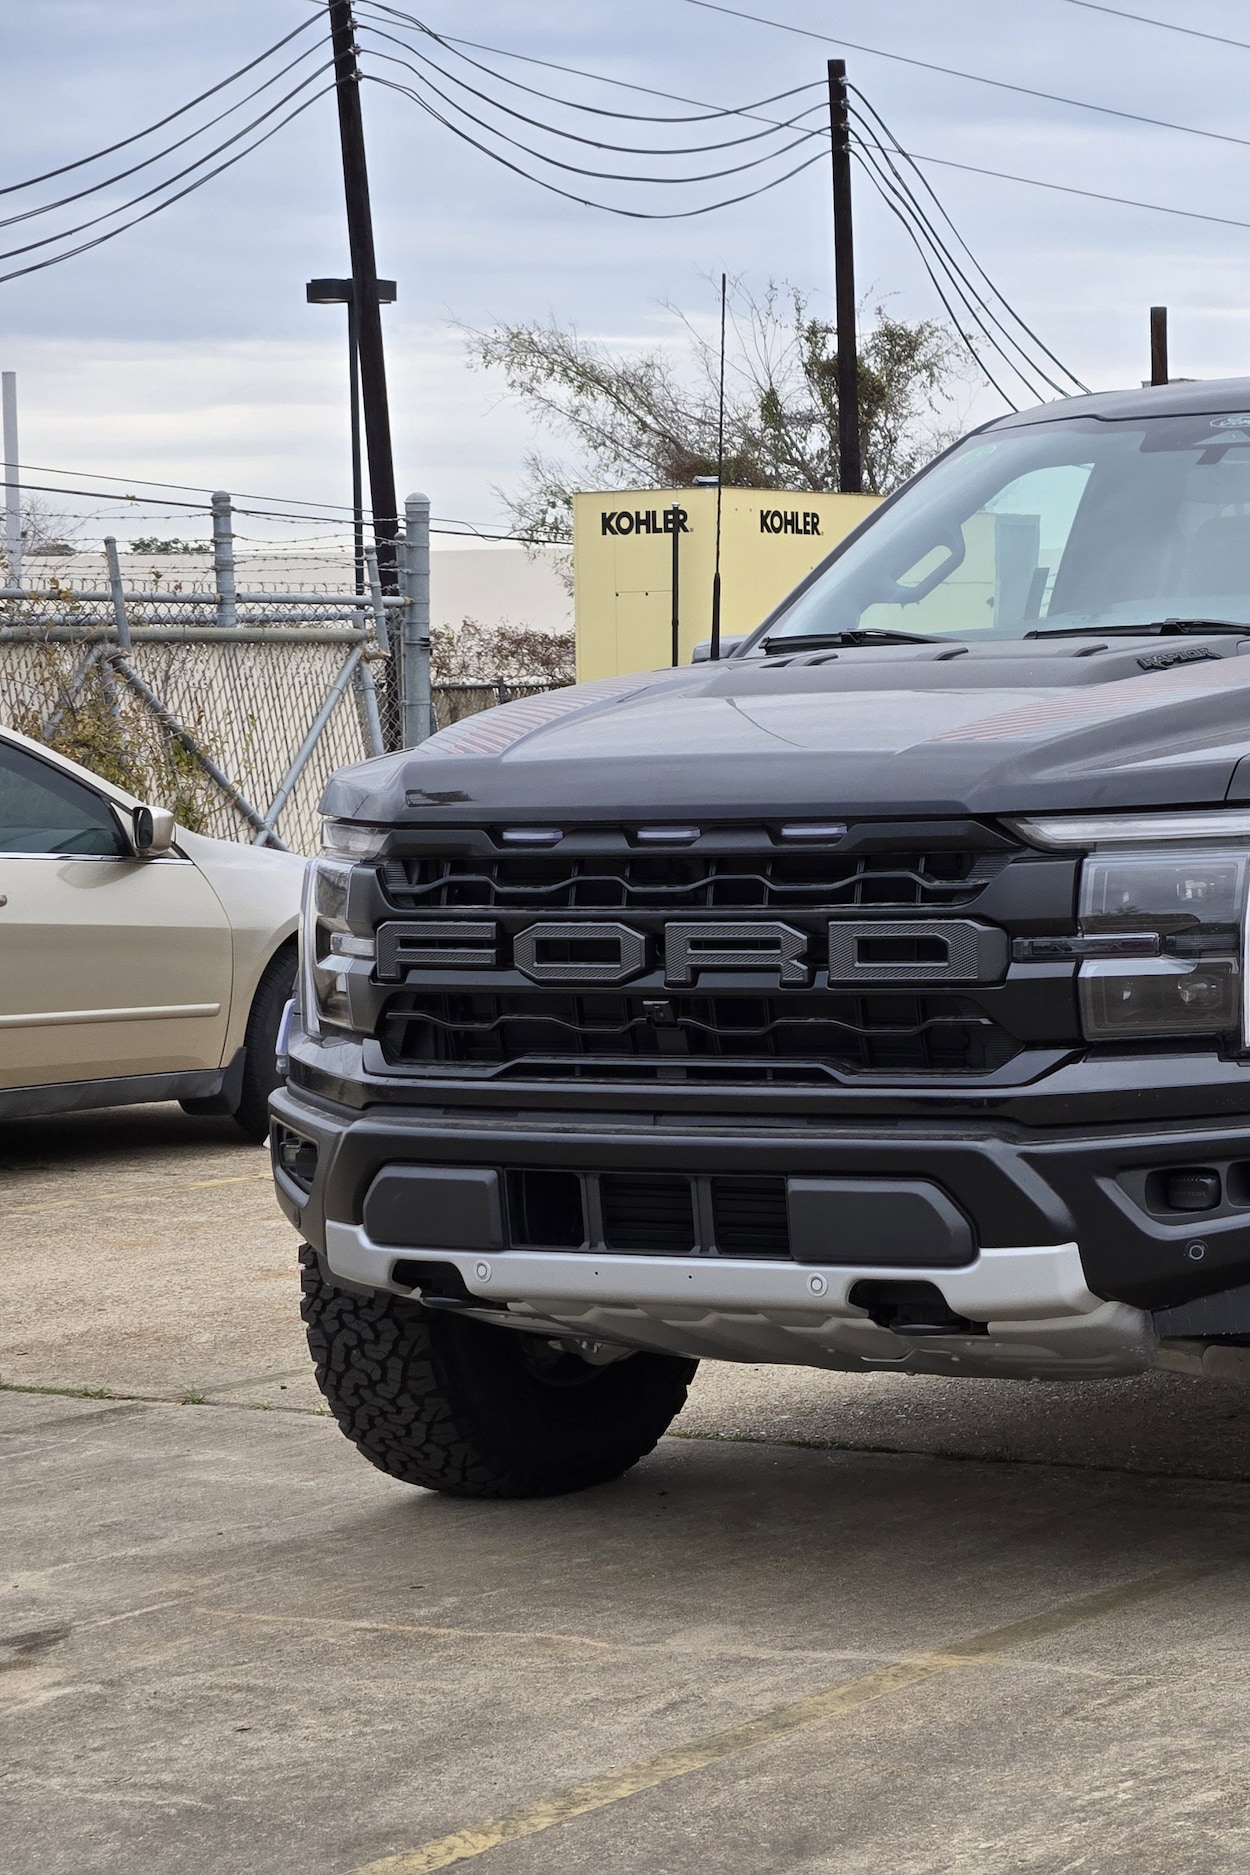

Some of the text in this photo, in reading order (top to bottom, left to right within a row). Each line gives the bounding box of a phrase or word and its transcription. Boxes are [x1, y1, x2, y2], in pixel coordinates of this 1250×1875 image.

[601, 509, 689, 536] KOHLER
[760, 509, 821, 536] KOHLER
[1137, 646, 1223, 670] RAPTOR
[375, 918, 1008, 988] FORD
